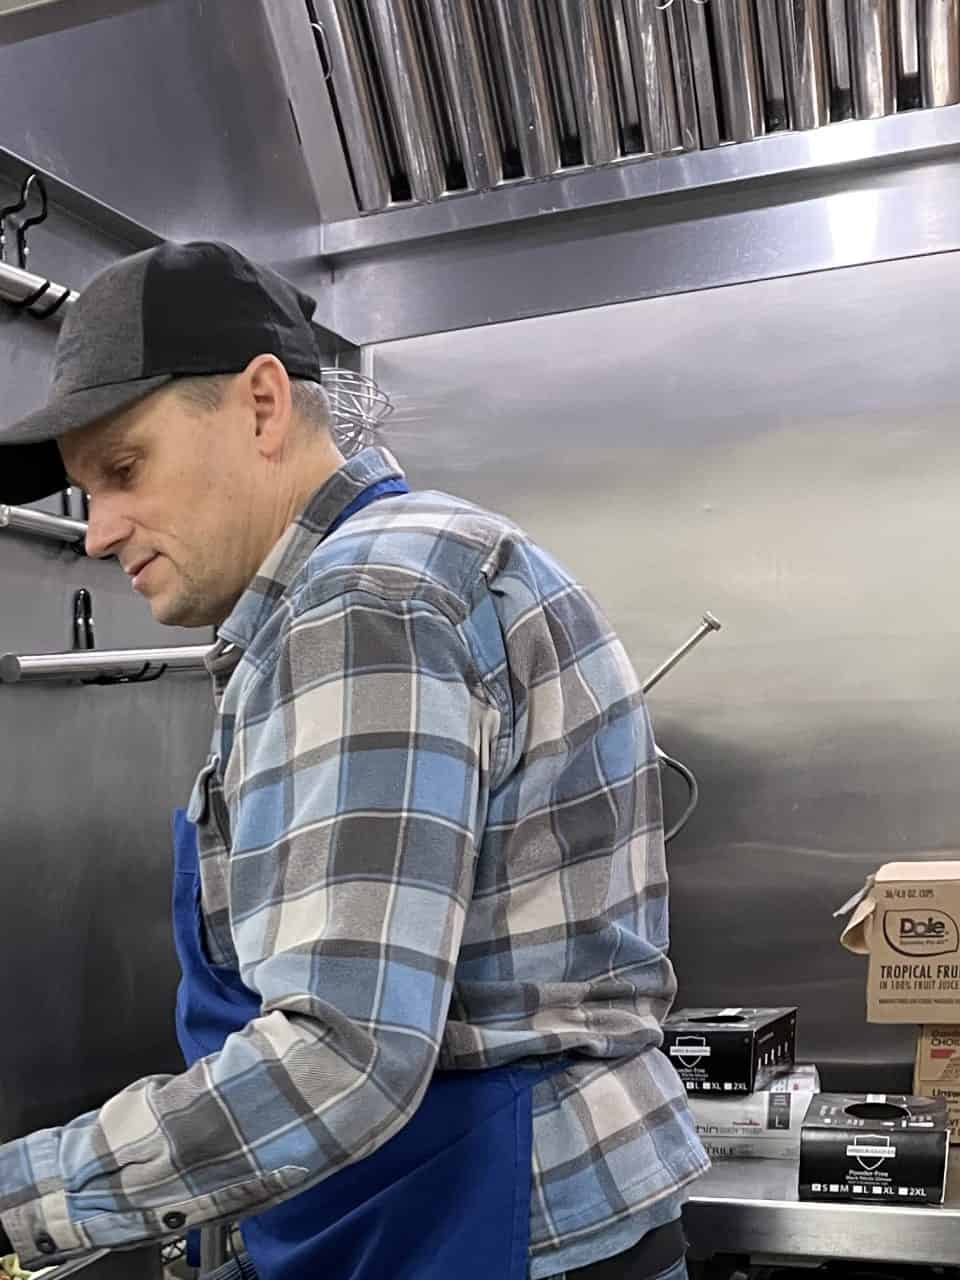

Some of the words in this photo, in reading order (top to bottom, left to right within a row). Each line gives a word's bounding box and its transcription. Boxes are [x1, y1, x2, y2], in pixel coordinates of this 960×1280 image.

[900, 917, 945, 936] Dole
[881, 965, 932, 979] TROPICAL
[936, 965, 960, 979] FRU
[914, 980, 936, 990] FRUIT
[711, 1082, 722, 1090] XL
[733, 1082, 748, 1090] 2XL
[883, 1186, 895, 1194] XL
[909, 1188, 927, 1197] 2XL
